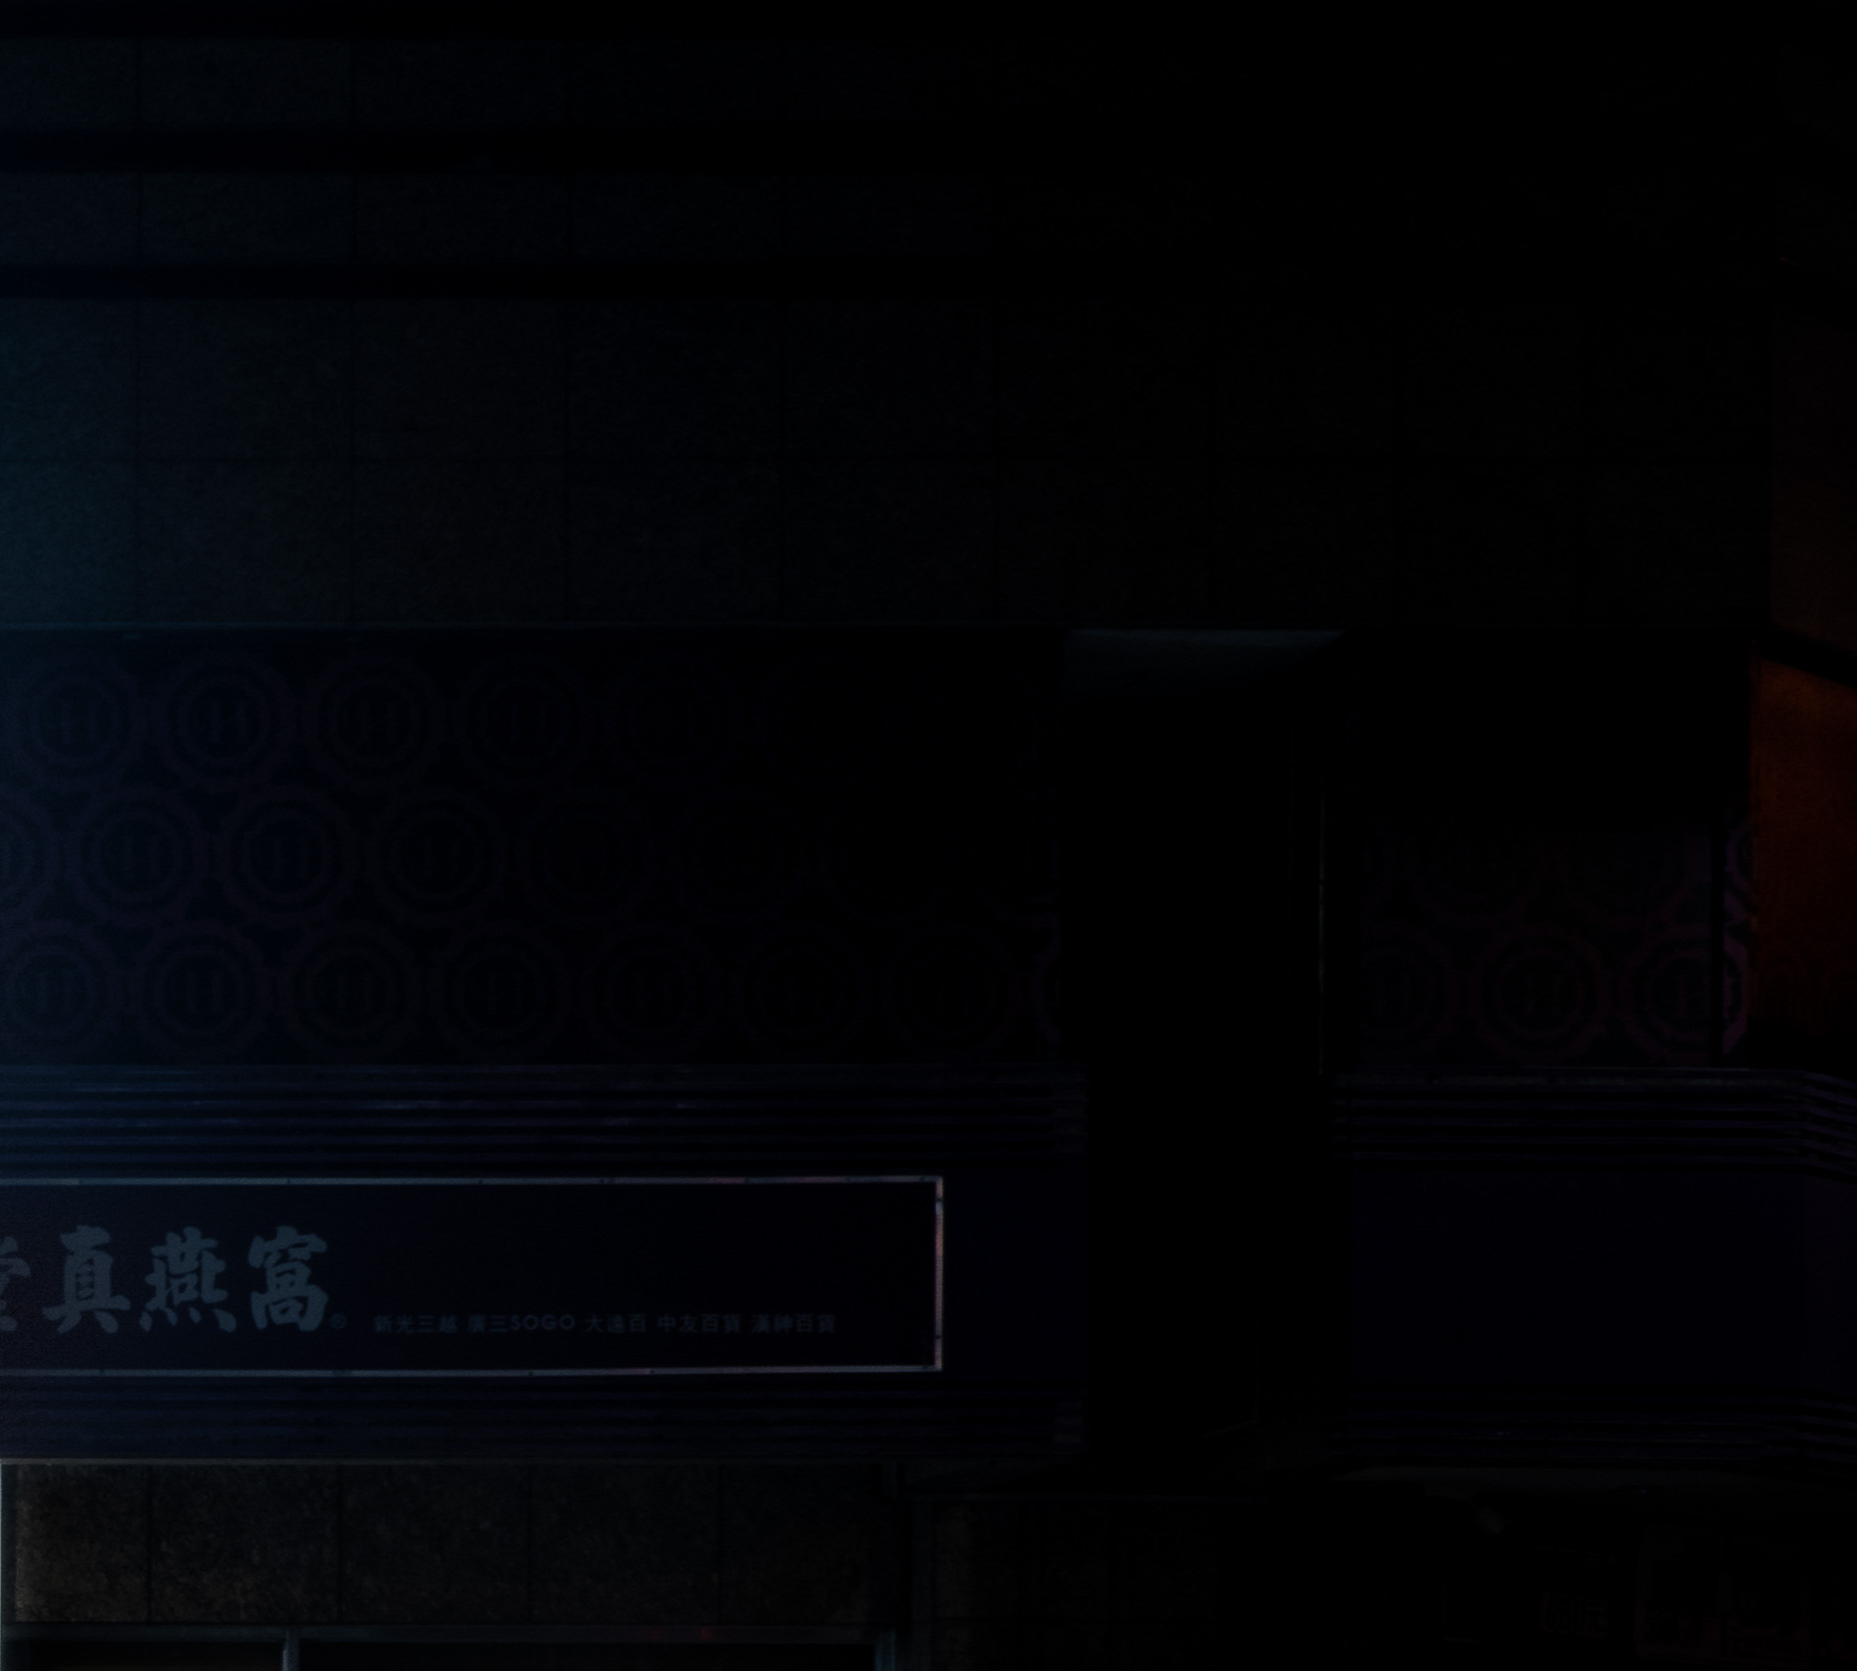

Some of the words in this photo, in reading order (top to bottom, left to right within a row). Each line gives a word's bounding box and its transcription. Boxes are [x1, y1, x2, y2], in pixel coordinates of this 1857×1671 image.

[373, 1313, 459, 1334] 新光三越
[584, 1313, 647, 1334] 大遠百
[657, 1313, 742, 1334] 中友百貨
